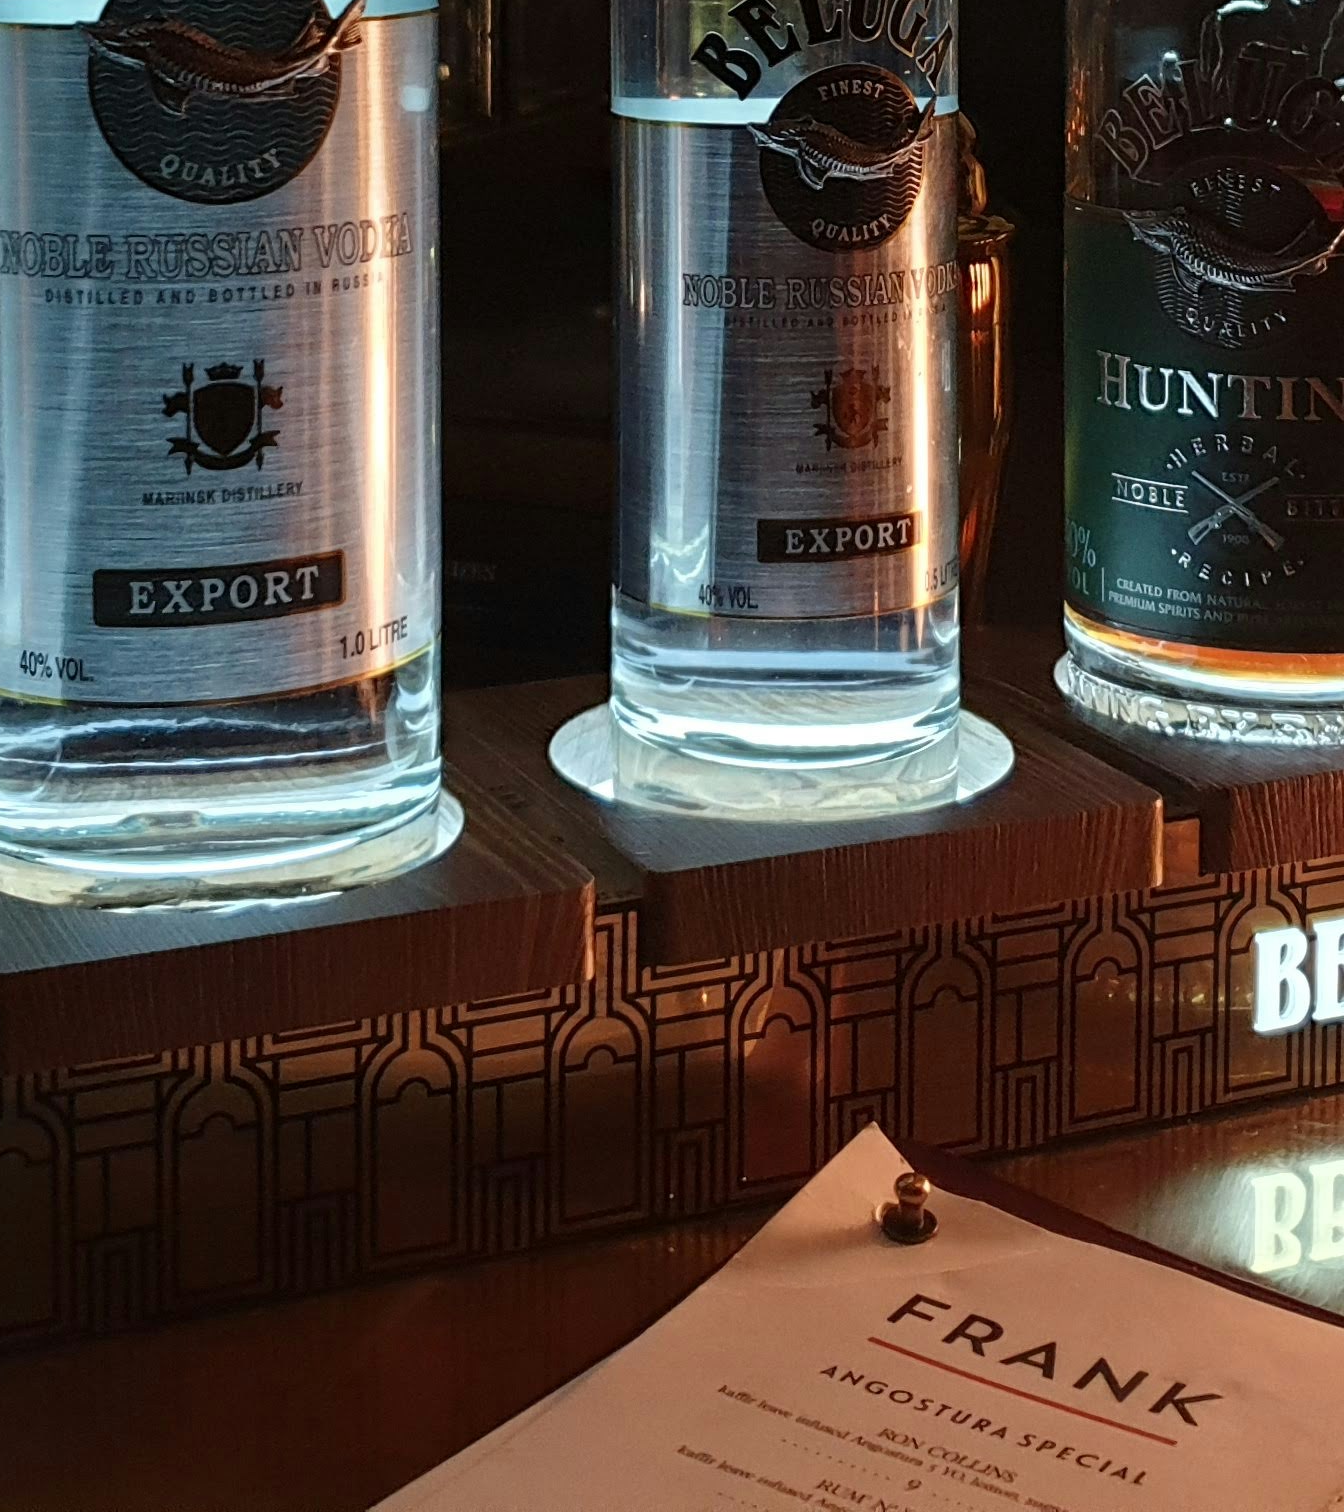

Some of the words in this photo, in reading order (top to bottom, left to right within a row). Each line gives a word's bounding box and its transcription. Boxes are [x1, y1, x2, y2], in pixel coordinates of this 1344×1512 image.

[818, 79, 885, 102] FINEST
[158, 147, 283, 186] QUALITY
[811, 213, 894, 242] QUALITY
[0, 230, 113, 280] NOBLE
[125, 226, 304, 280] RUSSIAN
[311, 212, 414, 269] VODKA
[45, 288, 144, 305] DISTILLED
[156, 288, 196, 305] AND
[208, 284, 295, 303] BOTTLED
[305, 280, 322, 295] IN
[682, 272, 777, 311] NOBLE
[786, 271, 906, 310] RUSSIAN
[221, 479, 304, 504] DISTILLERY
[1116, 479, 1186, 509] NOBLE
[785, 518, 912, 555] EXPORT
[129, 566, 321, 616] EXPORT
[698, 583, 724, 608] 40%
[1107, 589, 1156, 612] PREMIUM
[1158, 603, 1201, 621] SPIRITS
[1203, 610, 1233, 624] AND
[1115, 577, 1163, 598] CREATED
[1166, 588, 1202, 605] FROM
[338, 634, 366, 659] 1.0
[369, 615, 408, 652] LITRE
[19, 649, 54, 679] 40%
[886, 1293, 1224, 1427] FRANK
[819, 1364, 1009, 1440] ANGOSTURA
[1016, 1433, 1149, 1486] SPECIAL
[876, 1427, 925, 1451] RON
[927, 1445, 1019, 1485] COLLINS
